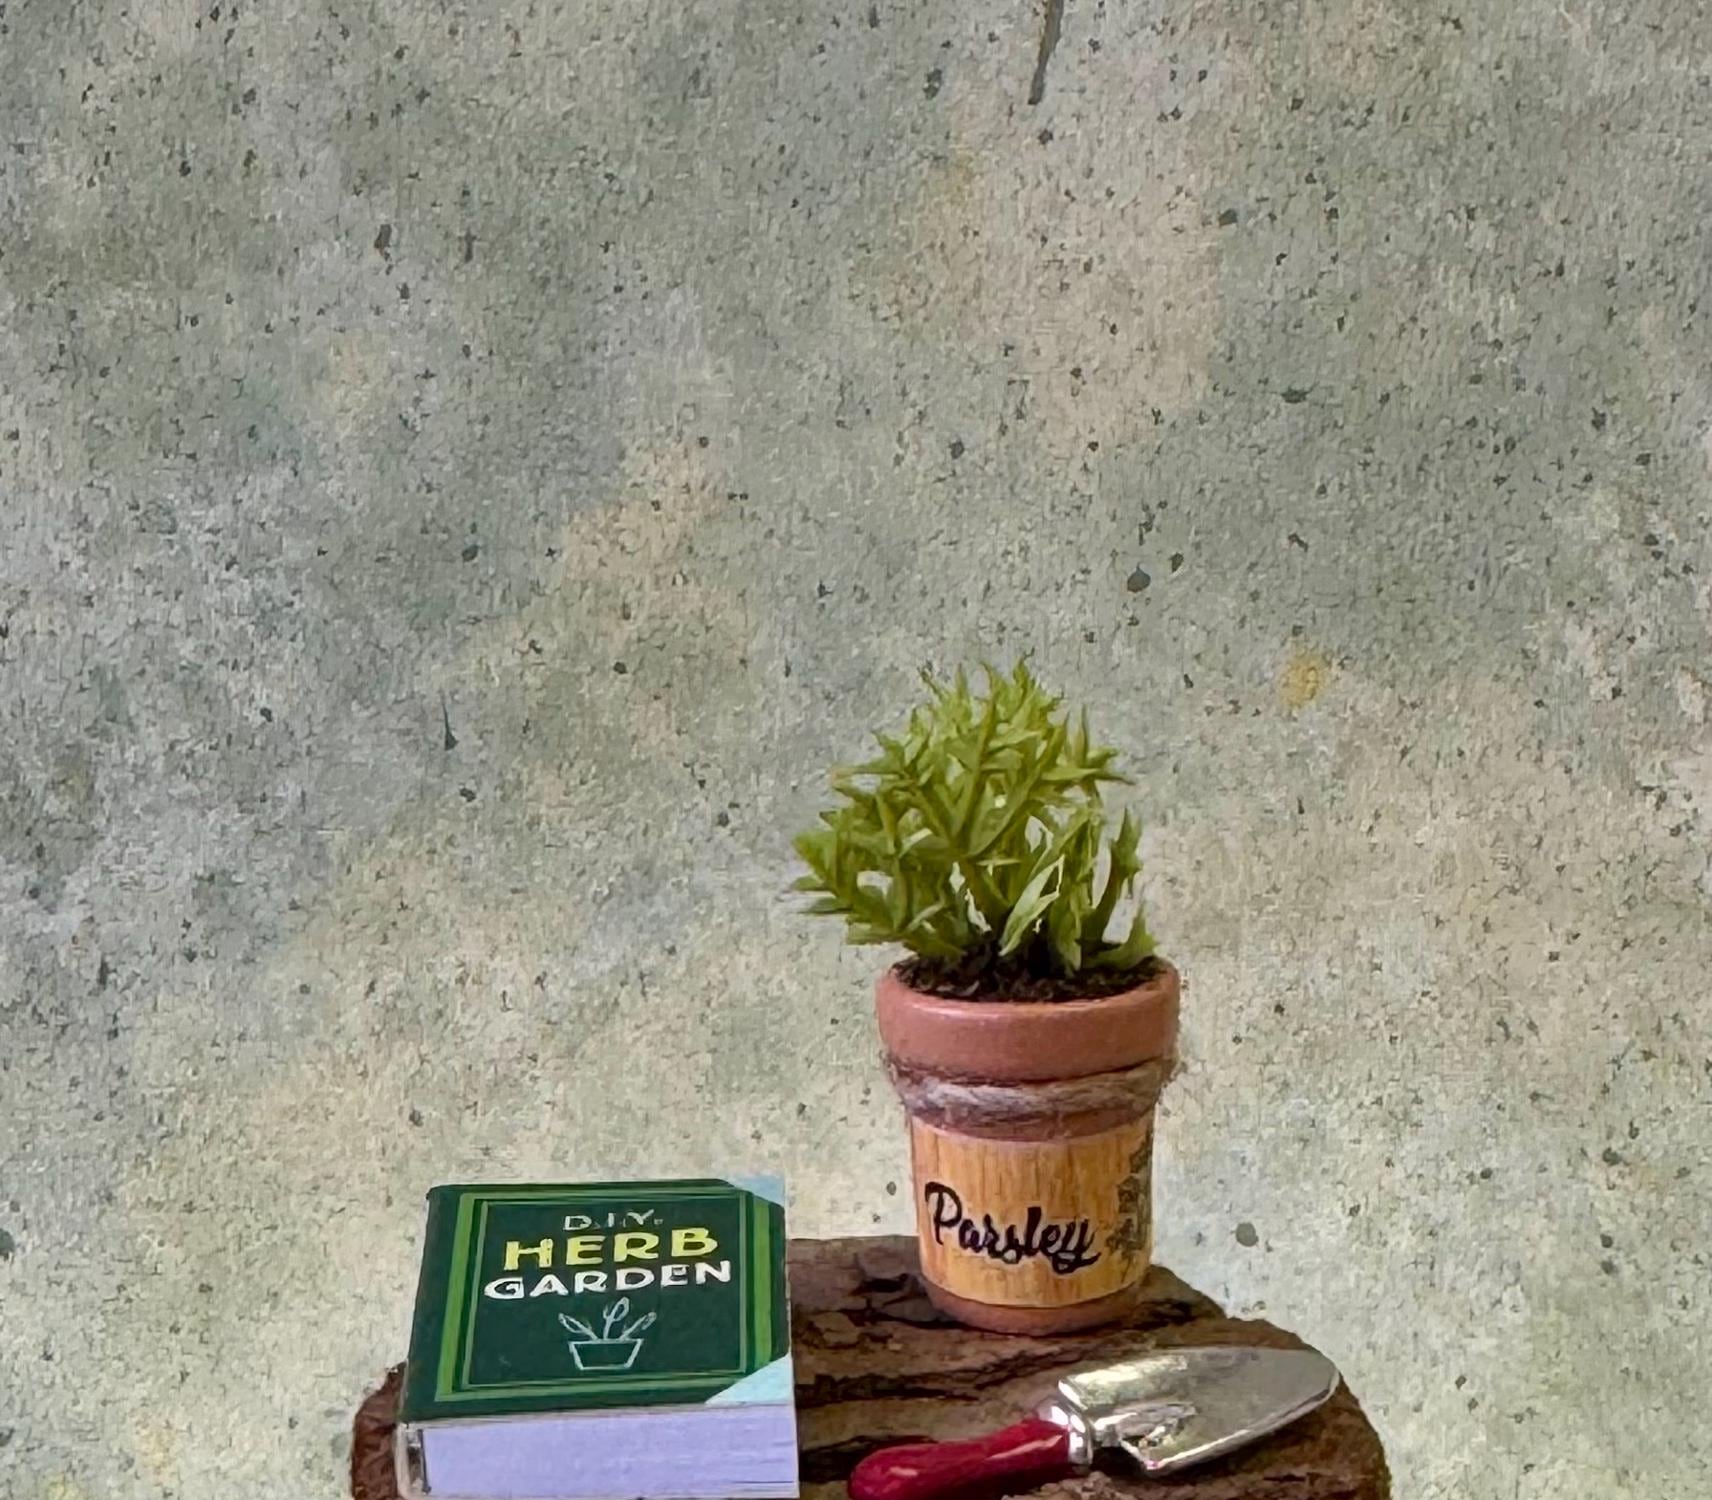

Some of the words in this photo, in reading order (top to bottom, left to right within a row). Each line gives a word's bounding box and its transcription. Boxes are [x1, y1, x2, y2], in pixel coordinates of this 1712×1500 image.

[503, 1227, 719, 1271] HERB
[924, 1181, 1100, 1274] Parsley
[484, 1260, 731, 1299] GARDEN
